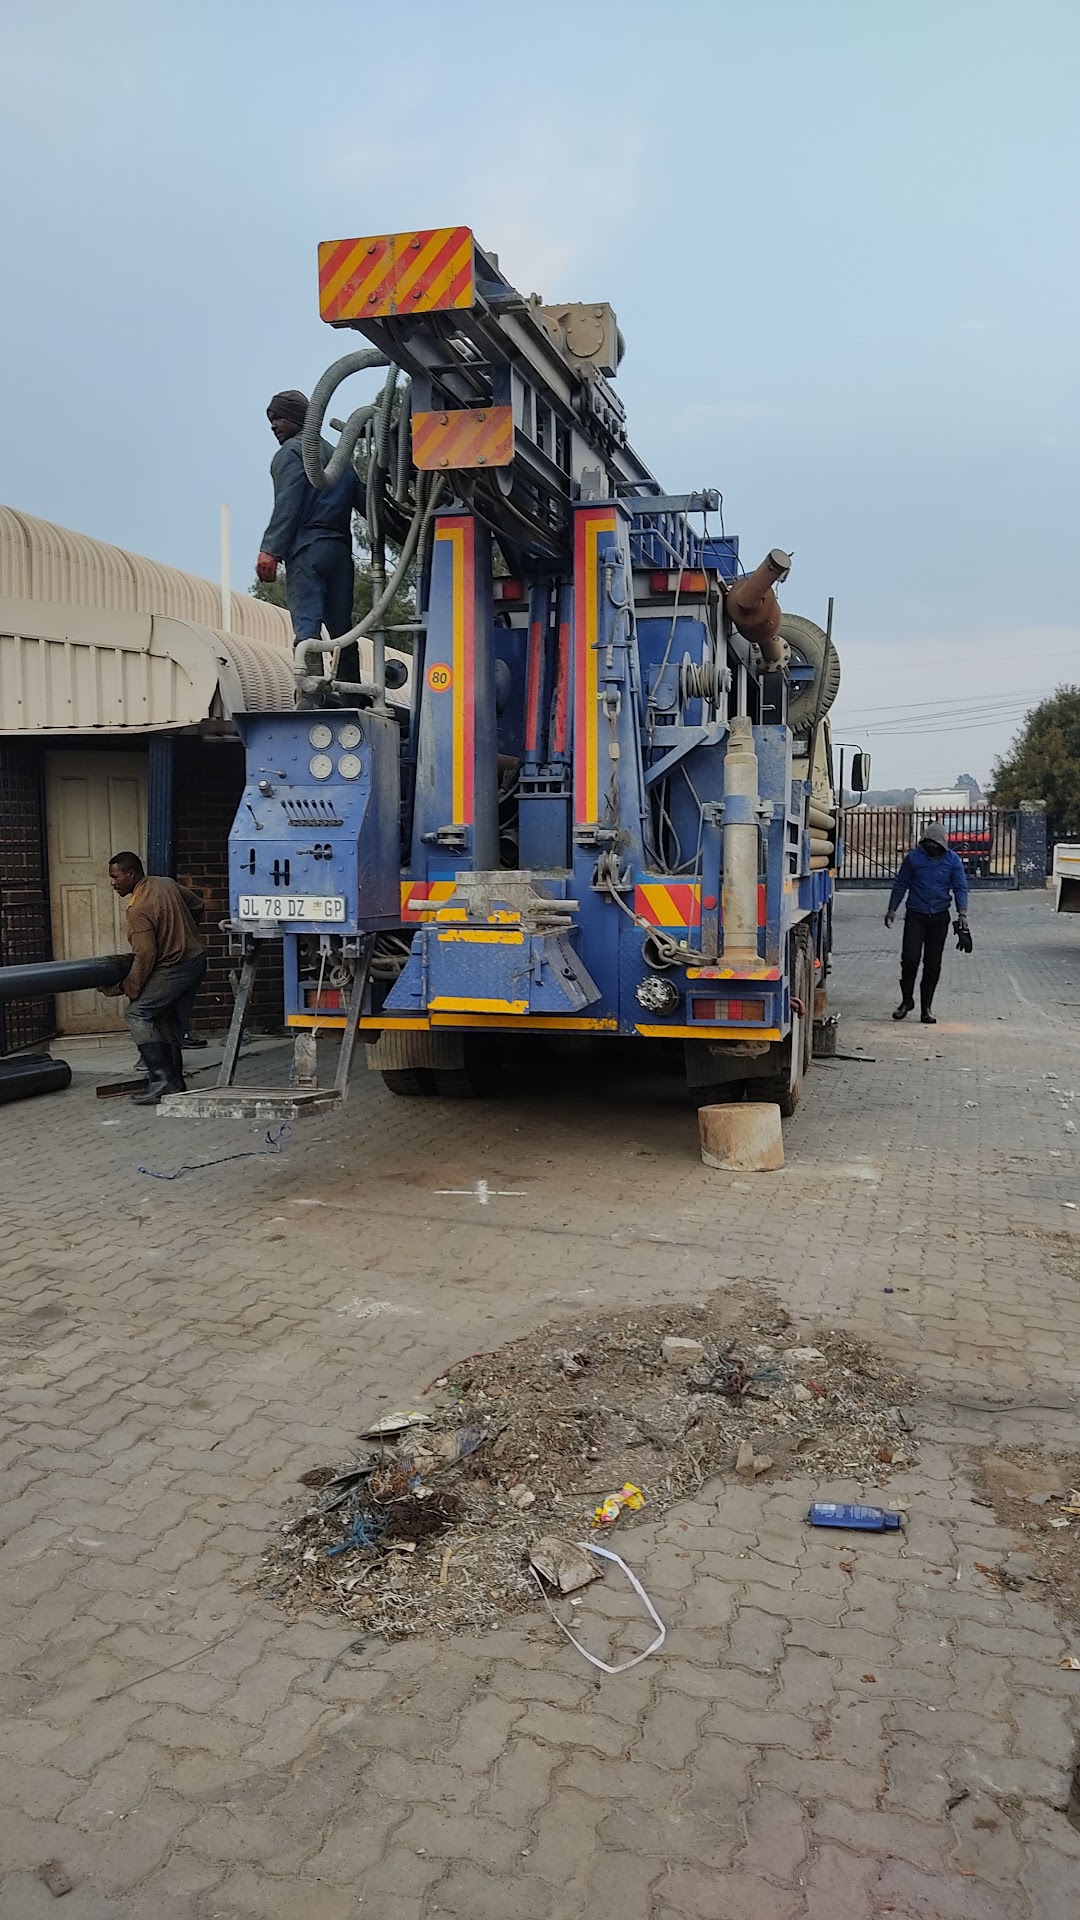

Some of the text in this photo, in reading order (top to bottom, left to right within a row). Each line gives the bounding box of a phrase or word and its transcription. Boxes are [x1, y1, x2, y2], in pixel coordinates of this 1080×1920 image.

[432, 672, 447, 684] 80
[243, 899, 342, 917] JL 78 DZ GP
